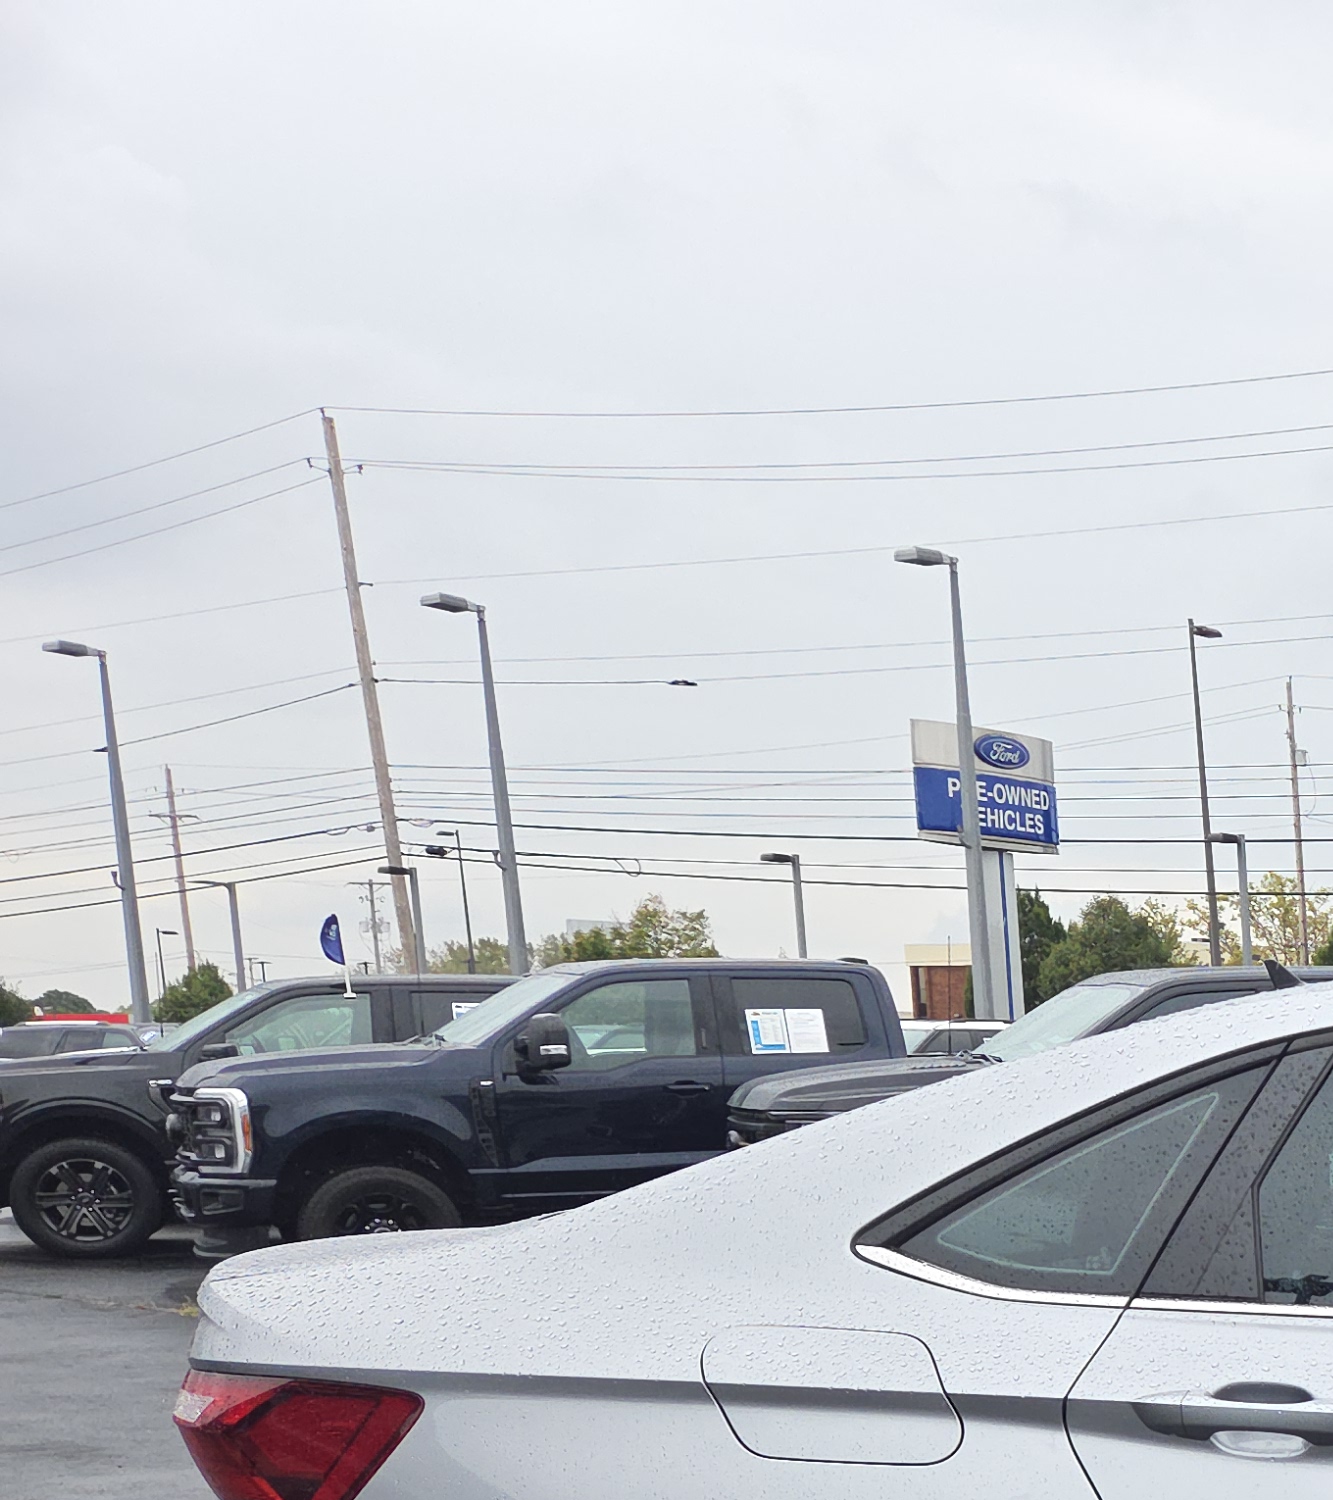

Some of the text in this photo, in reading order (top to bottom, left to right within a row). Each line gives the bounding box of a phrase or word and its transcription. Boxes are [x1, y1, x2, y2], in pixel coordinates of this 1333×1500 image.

[989, 741, 1020, 764] Ford
[947, 777, 1050, 811] PE-OWNED
[977, 807, 1045, 835] EHICLES
